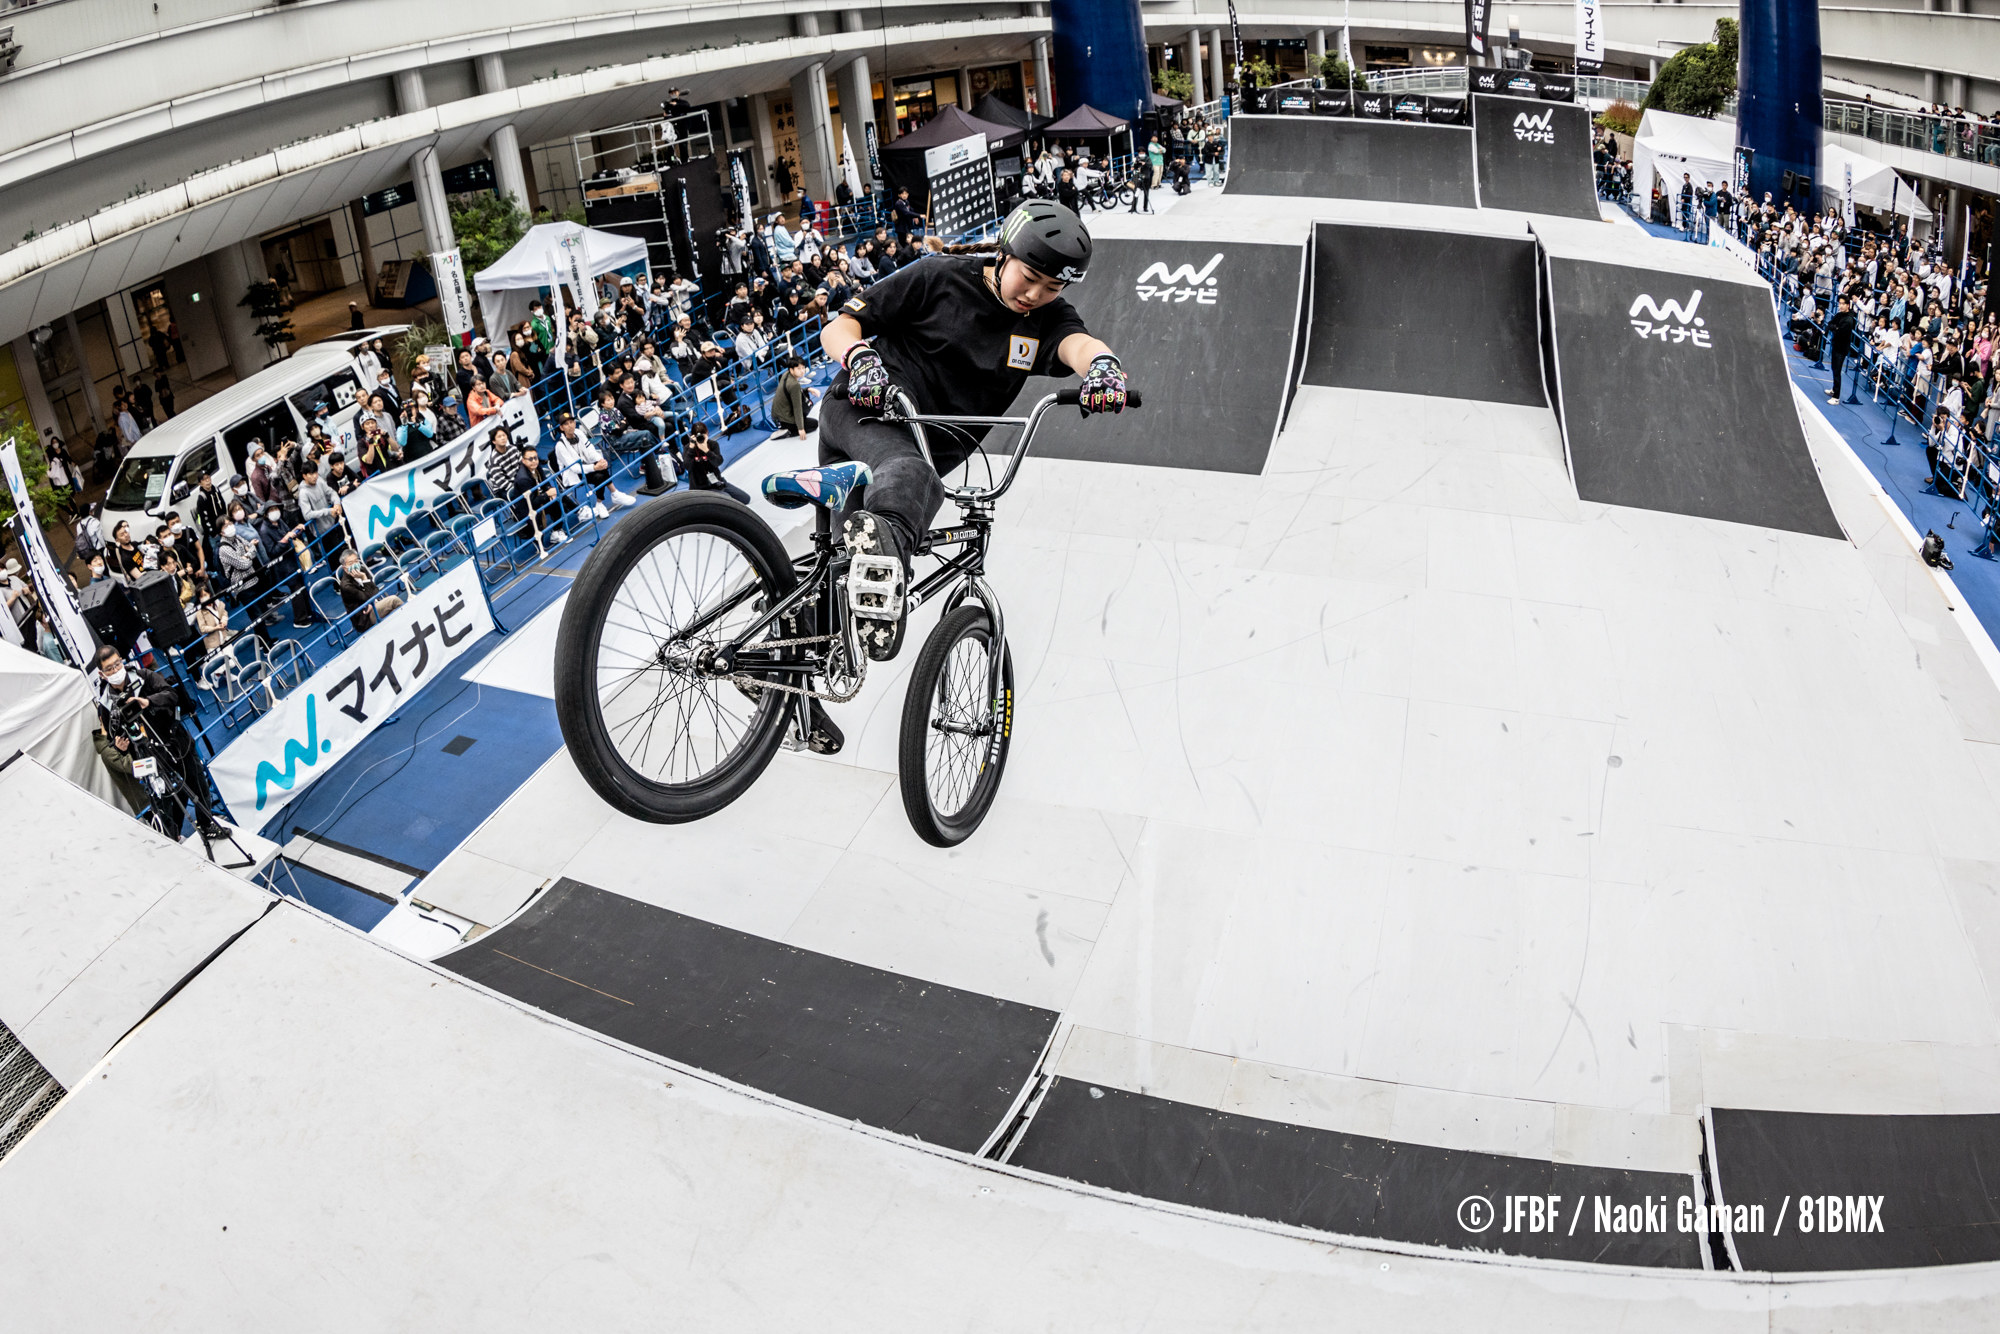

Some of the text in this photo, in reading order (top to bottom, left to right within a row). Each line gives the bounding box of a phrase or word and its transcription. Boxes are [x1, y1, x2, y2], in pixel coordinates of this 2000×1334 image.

[1583, 6, 1596, 53] マイナビ
[1508, 79, 1536, 89] JapanCup
[1281, 99, 1310, 107] JapanCup
[1395, 104, 1424, 113] JapanCup
[1513, 128, 1555, 144] マイナビ
[450, 270, 468, 330] 名古屋トヨペット
[1135, 285, 1218, 304] マイナビ
[1630, 319, 1713, 348] マイナビ
[1082, 391, 1125, 405] FIST
[325, 588, 474, 724] マイナビ
[1003, 689, 1013, 738] MAXXIS
